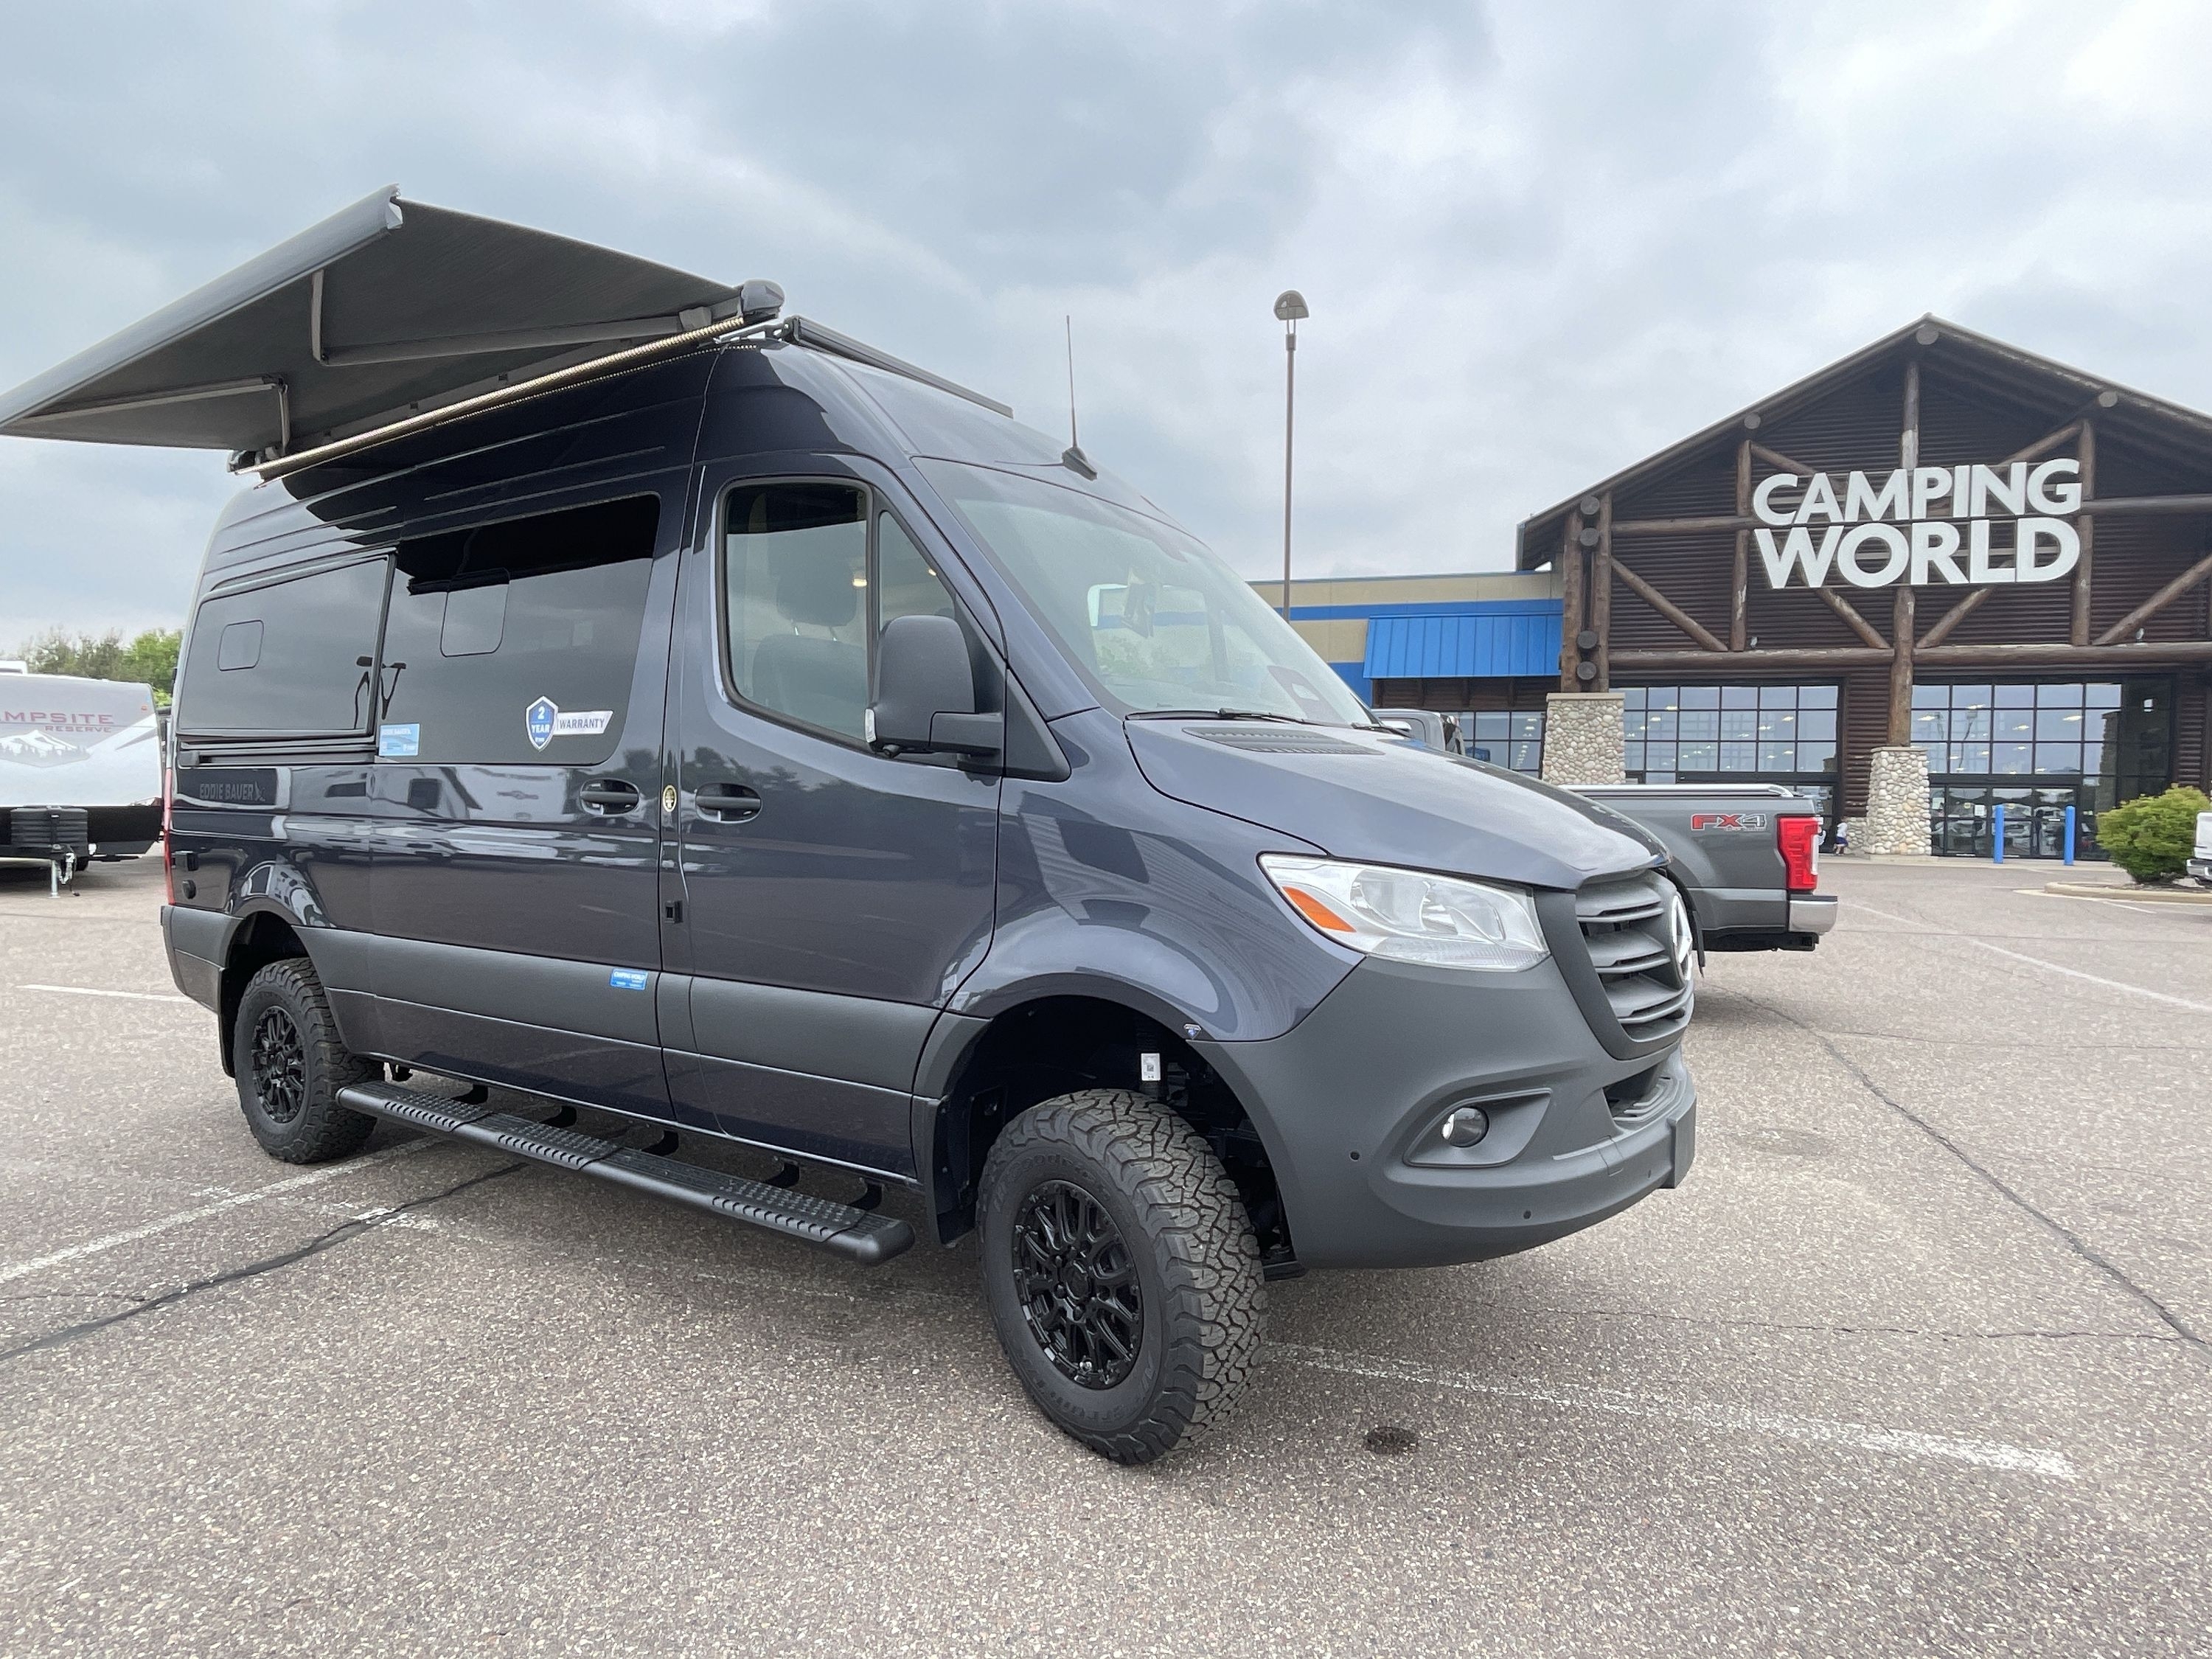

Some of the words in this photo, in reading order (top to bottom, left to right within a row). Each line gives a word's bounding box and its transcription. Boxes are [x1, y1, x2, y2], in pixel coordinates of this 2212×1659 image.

[1753, 458, 2082, 526] CAMPING
[1753, 517, 2081, 589] WORLD
[0, 711, 114, 724] MPSITE
[538, 706, 545, 720] 2
[45, 725, 112, 733] RESERVE
[531, 724, 550, 733] YEAR
[560, 718, 605, 729] WARRANTY
[200, 783, 224, 799] EDDIE
[225, 783, 254, 801] BAUER
[1691, 813, 1767, 831] FX4
